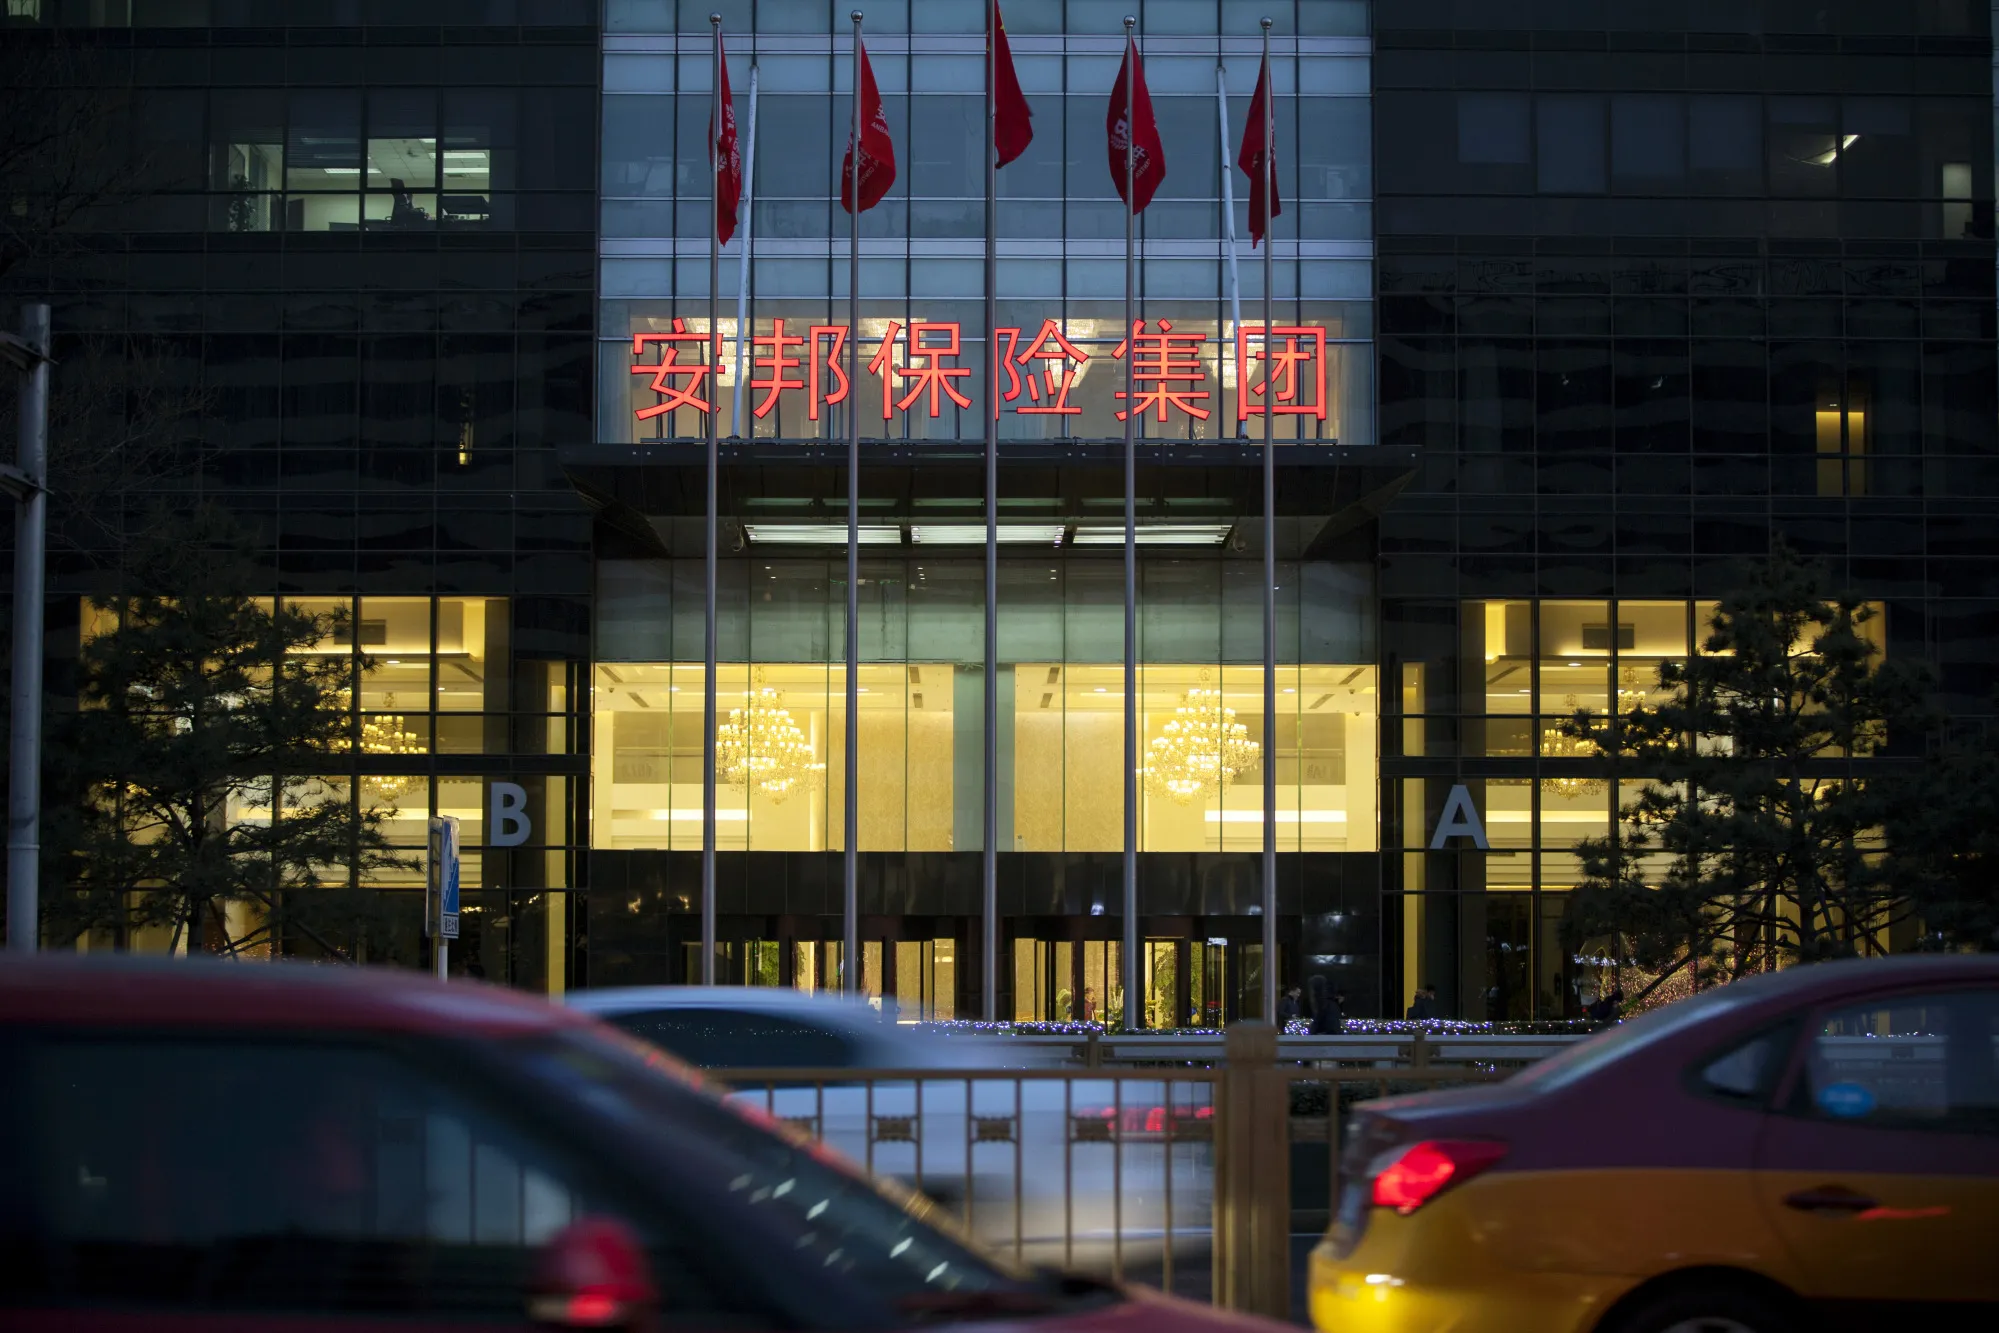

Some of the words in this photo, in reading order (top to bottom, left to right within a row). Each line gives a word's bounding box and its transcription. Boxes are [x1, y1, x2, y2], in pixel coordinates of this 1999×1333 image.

[630, 318, 1327, 421] 安邦保险集团
[490, 782, 532, 847] B
[1429, 784, 1491, 849] A
